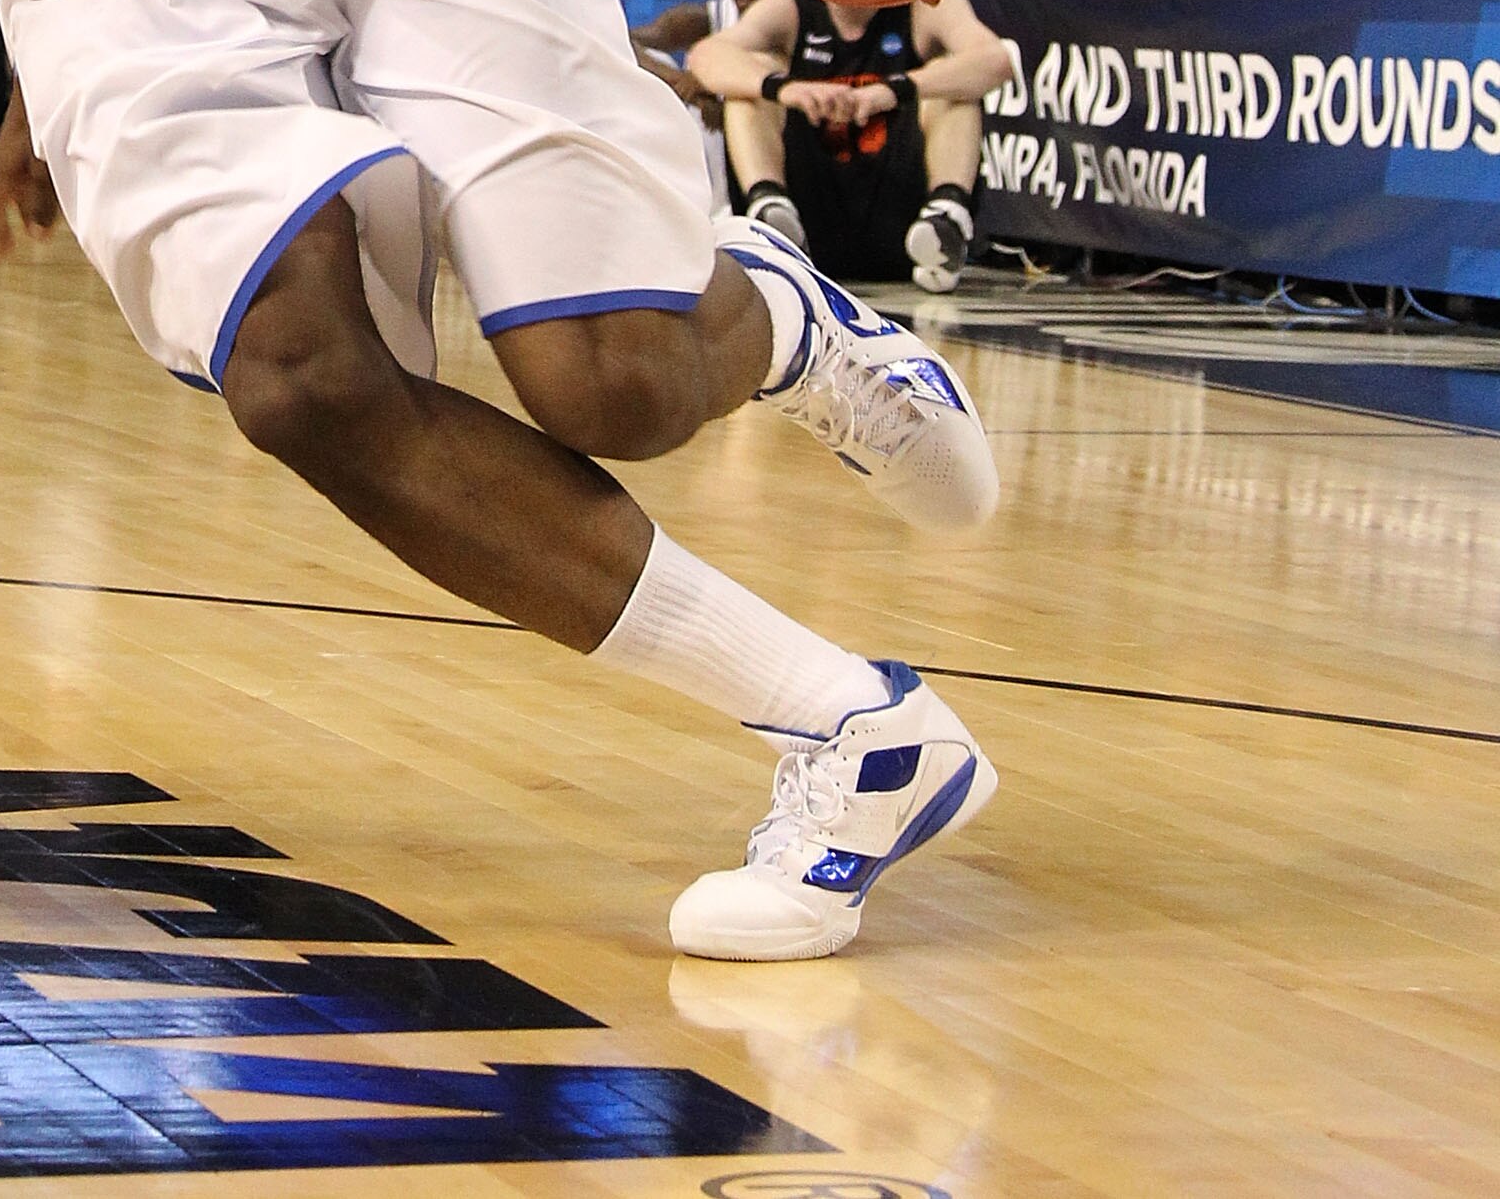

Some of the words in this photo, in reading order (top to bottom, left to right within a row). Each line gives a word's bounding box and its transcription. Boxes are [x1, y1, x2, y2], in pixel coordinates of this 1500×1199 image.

[1034, 42, 1131, 127] AND
[1134, 48, 1282, 140] THIRD
[1287, 54, 1500, 155] ROUNDS
[980, 131, 1067, 209] AMPA,
[1072, 141, 1207, 217] FLORIDA
